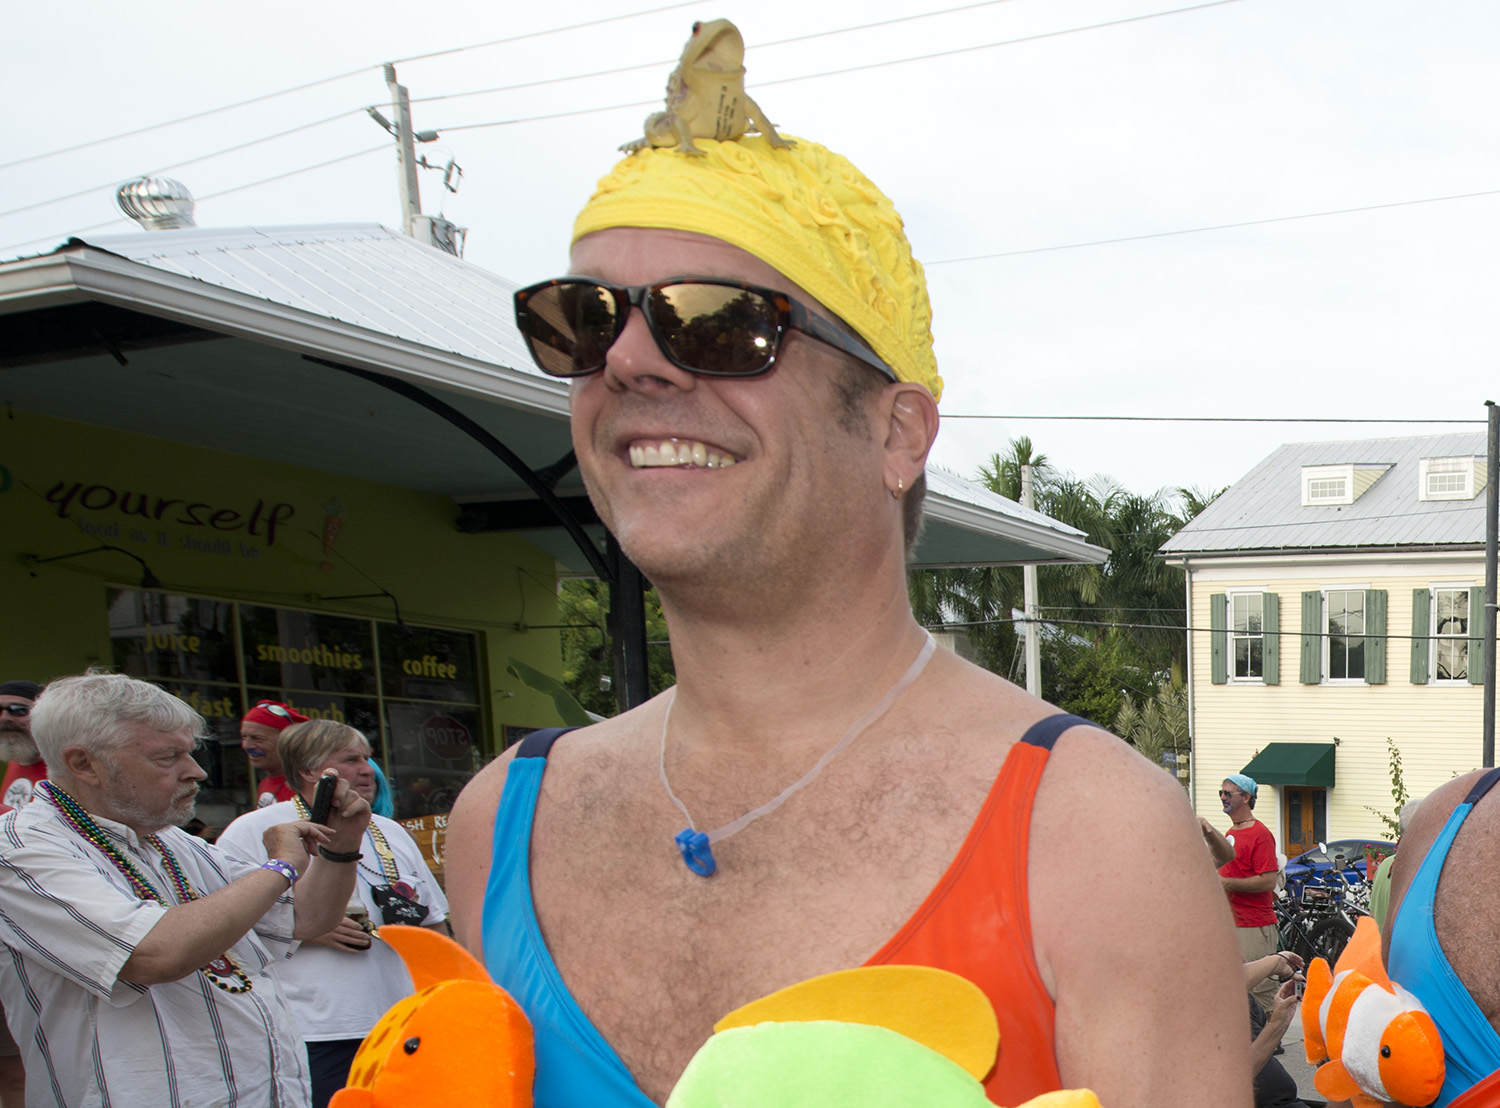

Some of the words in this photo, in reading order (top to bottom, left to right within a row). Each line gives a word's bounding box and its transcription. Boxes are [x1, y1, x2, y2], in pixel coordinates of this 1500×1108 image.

[45, 481, 296, 546] yourself
[144, 623, 201, 655] juice
[257, 643, 362, 670] smoothies
[401, 654, 458, 681] coffee
